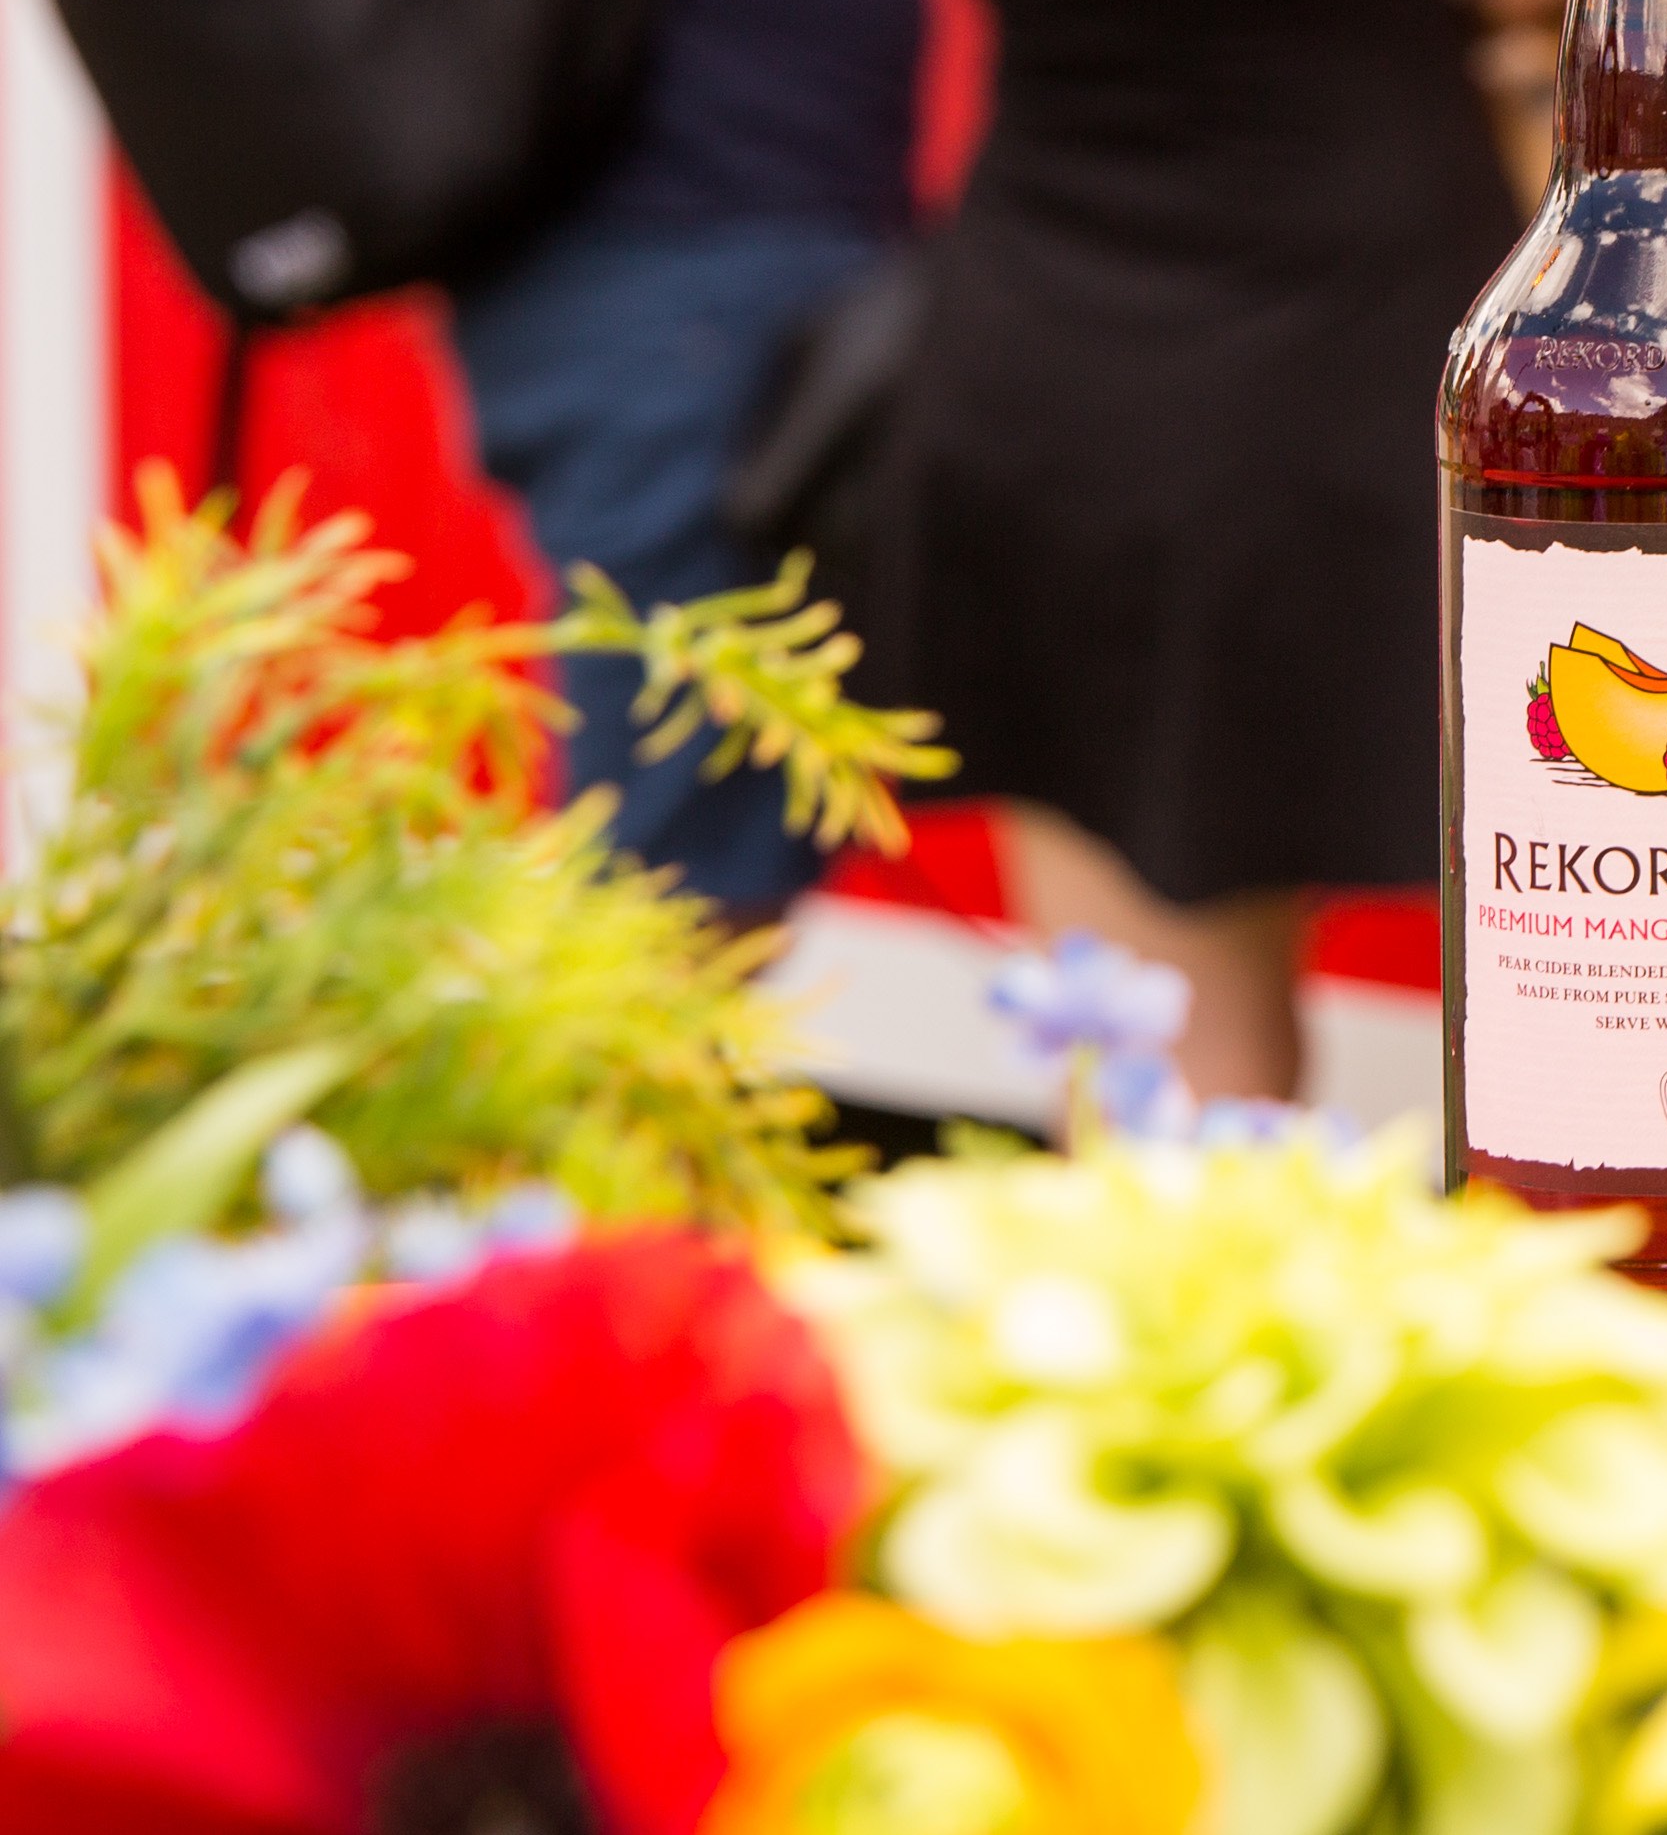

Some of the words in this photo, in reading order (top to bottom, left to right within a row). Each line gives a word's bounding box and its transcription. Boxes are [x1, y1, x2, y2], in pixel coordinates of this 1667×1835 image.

[1479, 904, 1573, 938] PREMIUM
[1498, 954, 1532, 972] PEAR
[1534, 959, 1583, 976] CIDER
[1517, 983, 1560, 1001] MADE
[1563, 987, 1609, 1004] FROM
[1615, 991, 1661, 1005] PURE
[1596, 1017, 1650, 1031] SERVE
